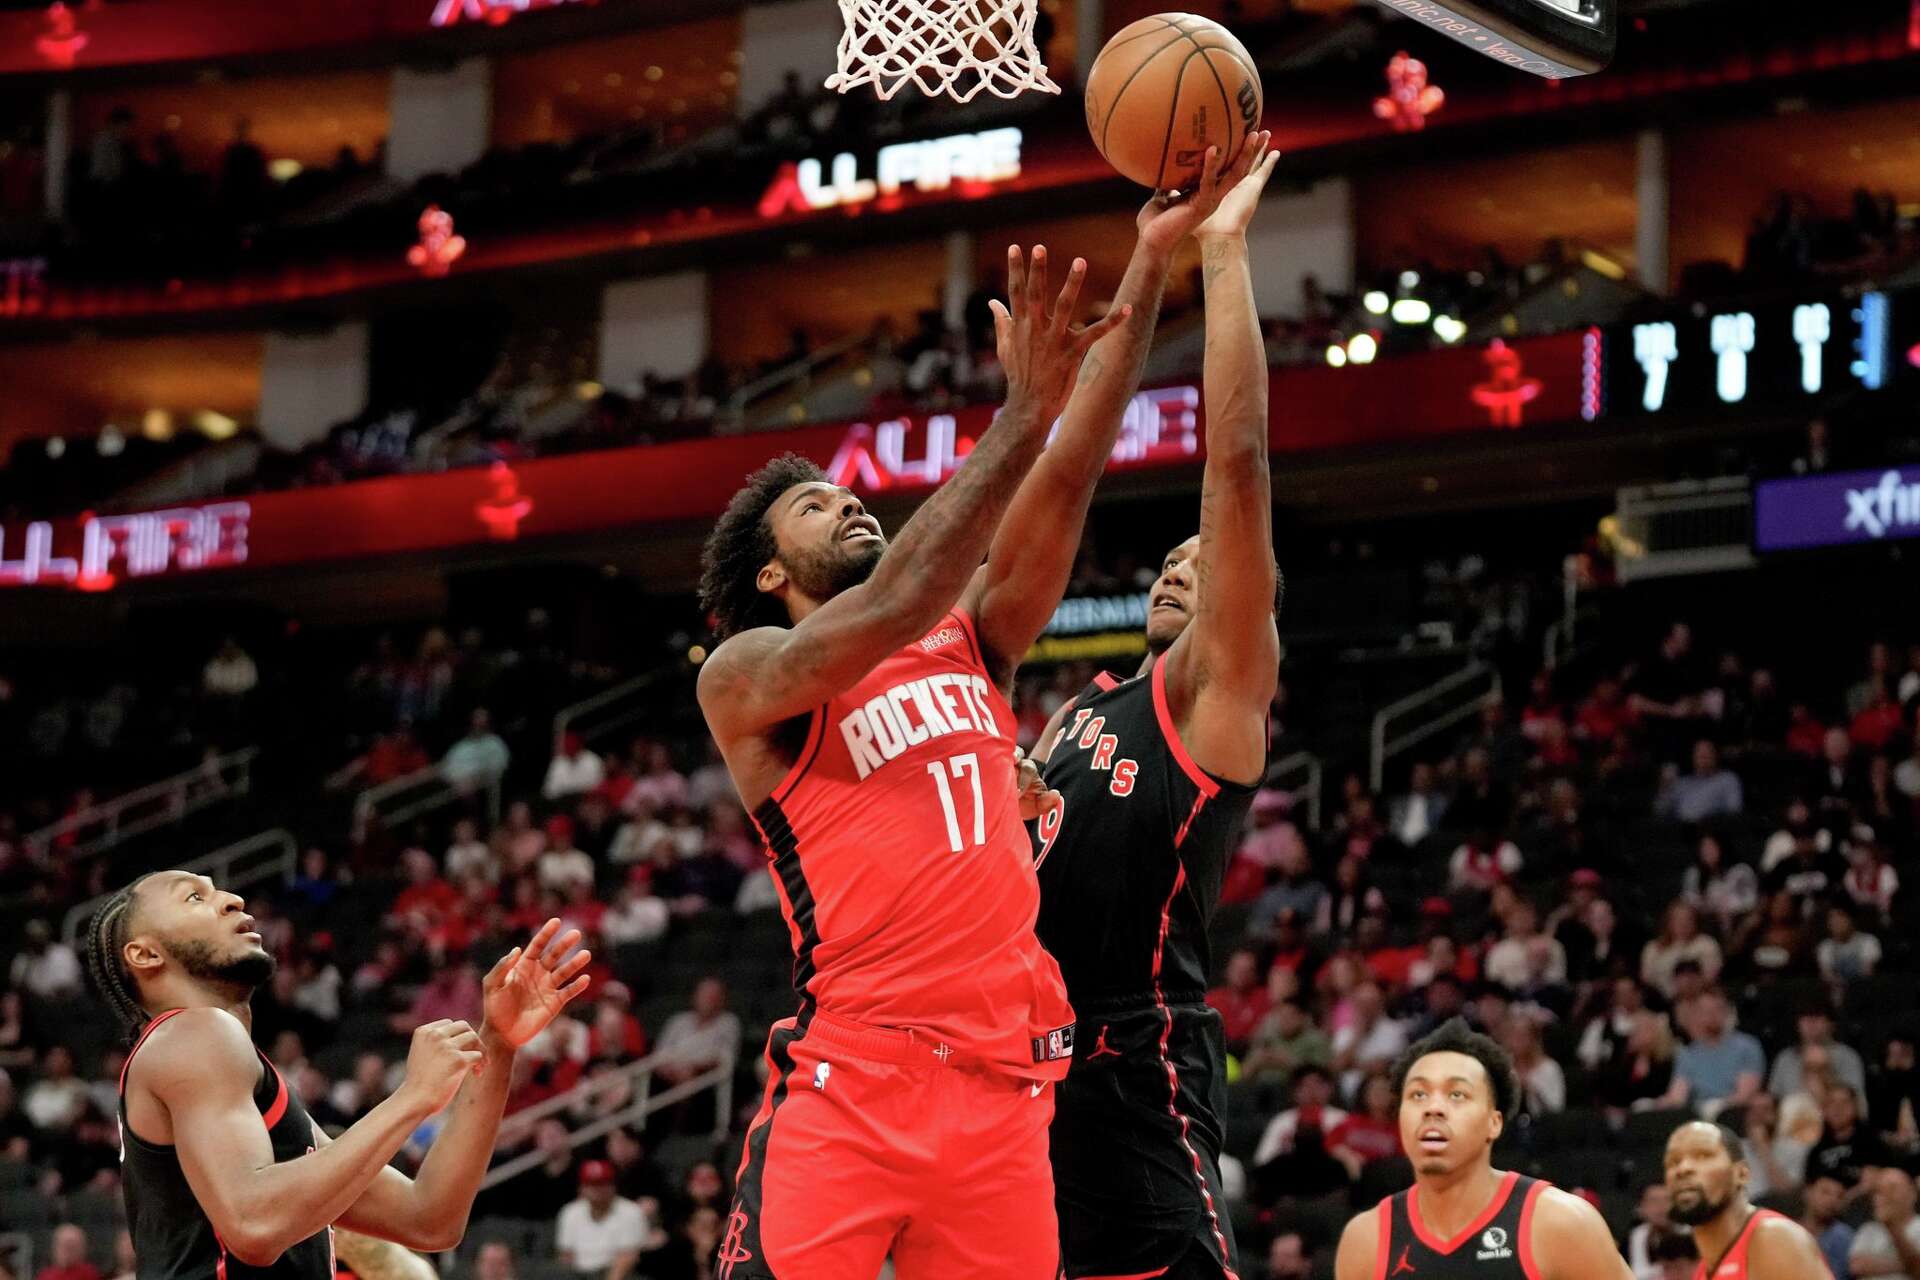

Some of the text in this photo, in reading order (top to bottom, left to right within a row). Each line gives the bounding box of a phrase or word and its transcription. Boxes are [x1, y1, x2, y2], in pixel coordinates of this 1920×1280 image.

[759, 152, 877, 216] ALL
[839, 672, 1001, 782] ROCKETS
[926, 752, 986, 852] 17
